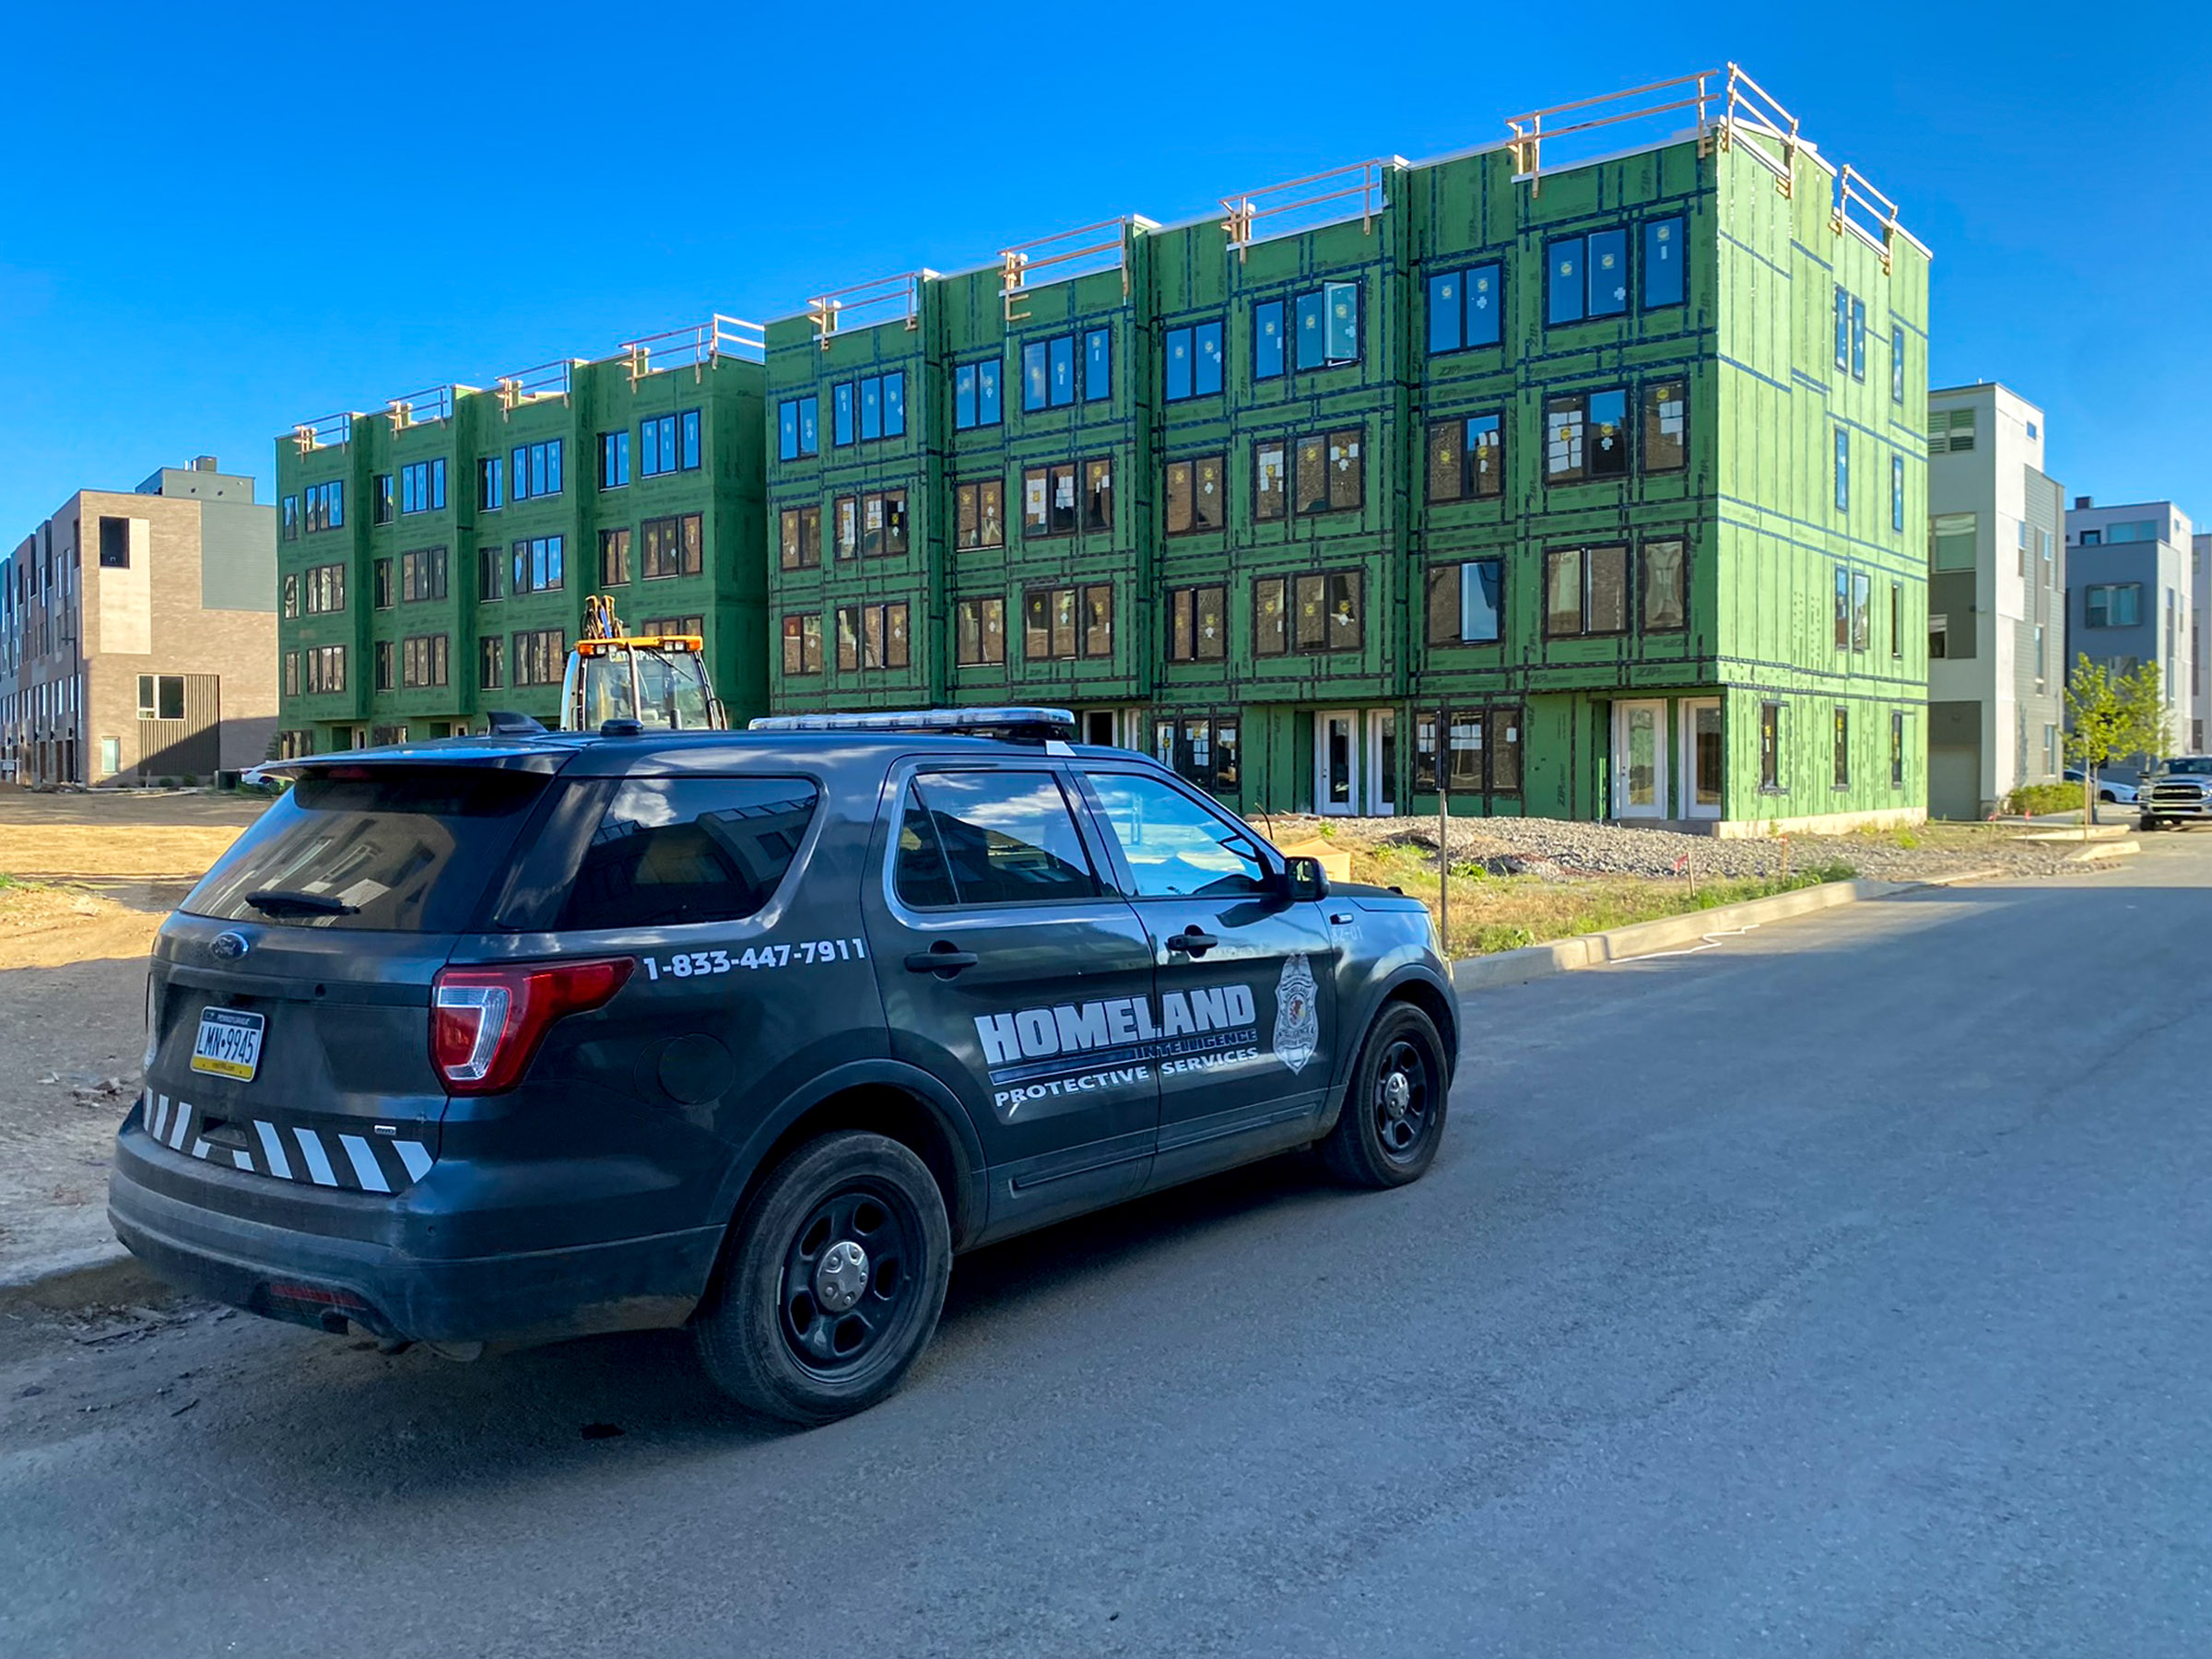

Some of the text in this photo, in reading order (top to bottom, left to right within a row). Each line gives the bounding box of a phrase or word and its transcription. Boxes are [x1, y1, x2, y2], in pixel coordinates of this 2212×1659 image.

[643, 937, 865, 981] 1-833-447-7911
[973, 983, 1256, 1065] HOMELAND
[1135, 1027, 1258, 1060] INTELLIGENCE
[994, 1046, 1259, 1107] PROTECTIVE SERVICES
